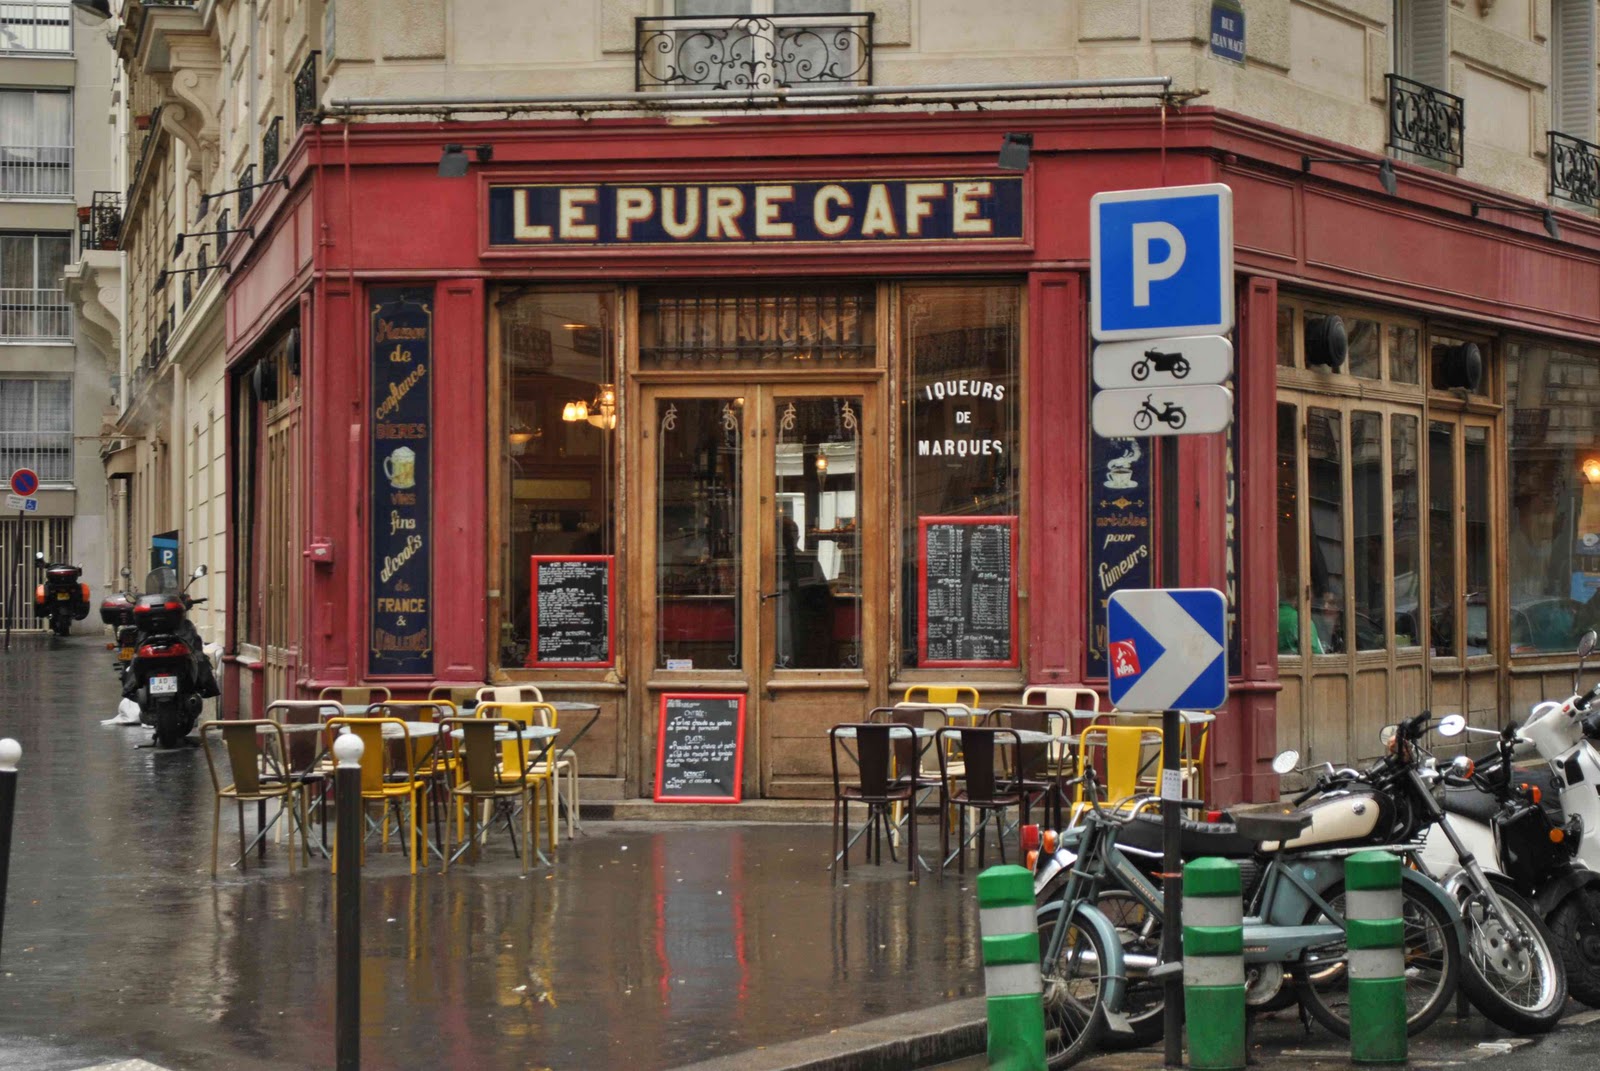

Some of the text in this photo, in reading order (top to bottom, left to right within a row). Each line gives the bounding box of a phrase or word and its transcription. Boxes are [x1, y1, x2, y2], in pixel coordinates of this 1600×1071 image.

[513, 189, 598, 240] LE
[616, 186, 795, 240] PURE
[1132, 221, 1187, 307] P
[390, 344, 411, 362] de
[376, 363, 427, 419] confiance
[956, 411, 971, 423] DE
[919, 440, 1003, 457] MARQUES
[390, 510, 416, 535] fins
[1096, 512, 1148, 527] articles
[1103, 533, 1135, 549] pour
[163, 550, 173, 564] P
[380, 534, 423, 582] alcools
[1098, 544, 1148, 591] fumeurs
[377, 598, 427, 612] FRANCE
[396, 615, 407, 626] &
[1116, 664, 1136, 676] NPA
